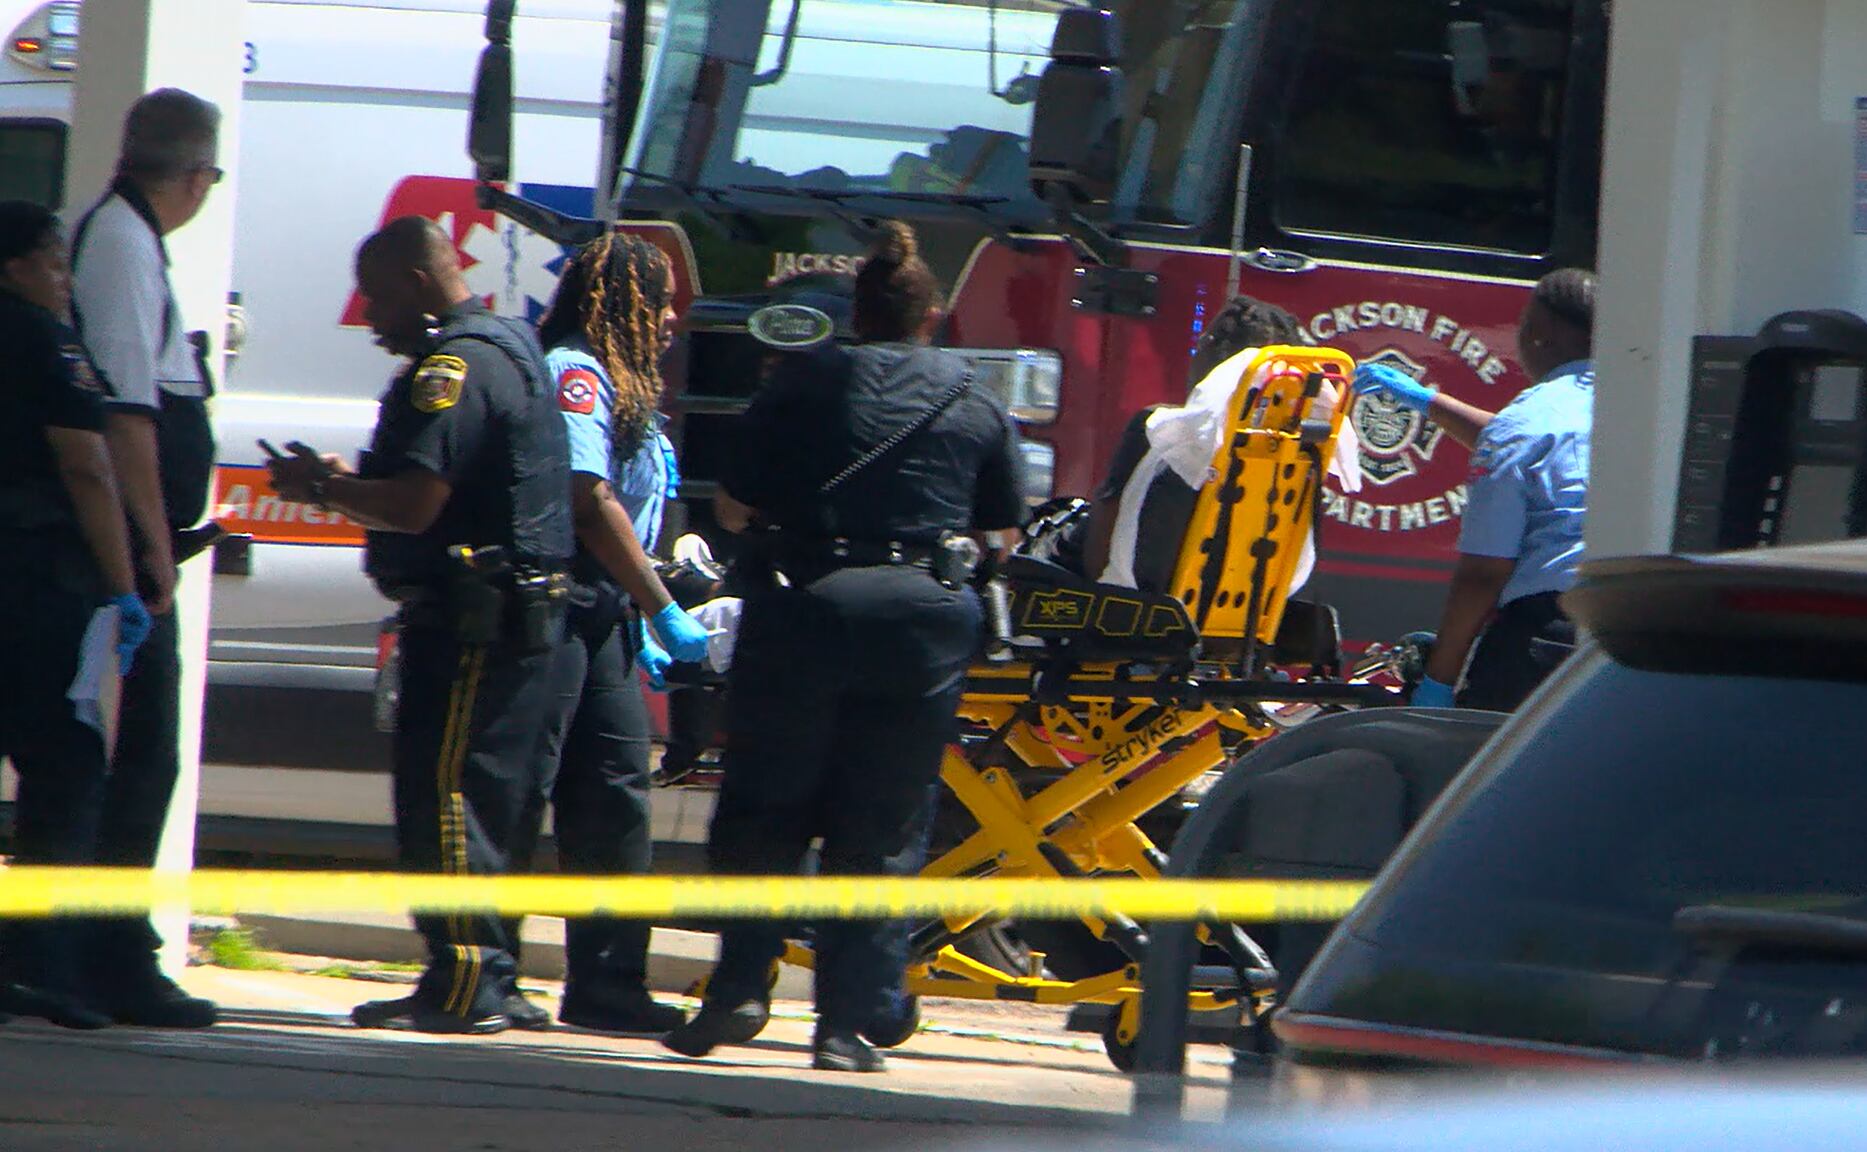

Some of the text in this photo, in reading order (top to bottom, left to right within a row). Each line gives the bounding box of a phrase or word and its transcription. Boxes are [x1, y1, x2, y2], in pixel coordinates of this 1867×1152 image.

[766, 252, 866, 286] JACKS
[1429, 315, 1508, 385] FIRE
[1322, 484, 1469, 531] PARTMEN
